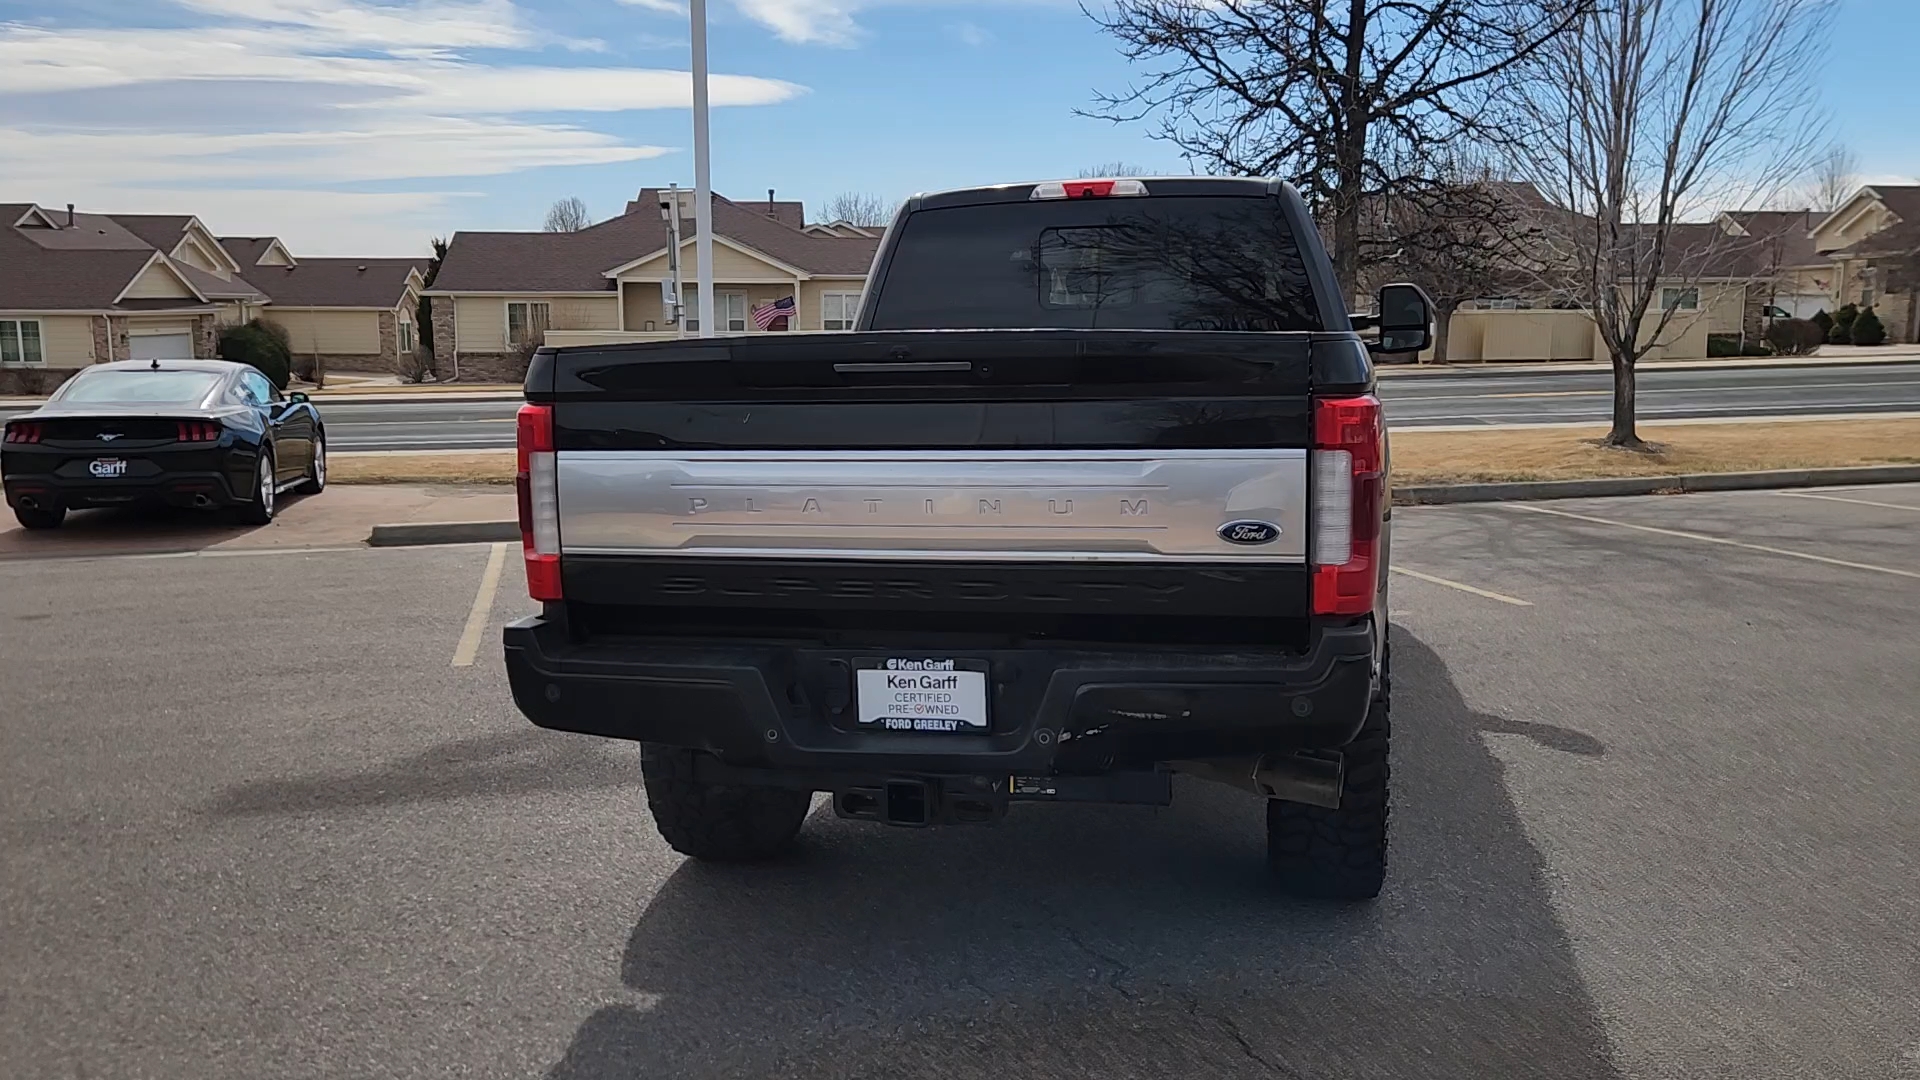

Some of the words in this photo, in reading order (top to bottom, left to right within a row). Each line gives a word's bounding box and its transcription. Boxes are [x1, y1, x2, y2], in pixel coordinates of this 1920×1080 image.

[89, 460, 127, 474] Garff
[688, 497, 1149, 516] PLATINUM
[1231, 524, 1268, 540] Ford
[898, 659, 923, 671] Ken
[923, 659, 955, 671] Garff
[887, 674, 917, 689] Ken
[919, 675, 958, 690] Garff
[894, 692, 952, 703] CERTIFIED
[885, 718, 912, 730] FORD
[913, 718, 958, 731] GREELEY
